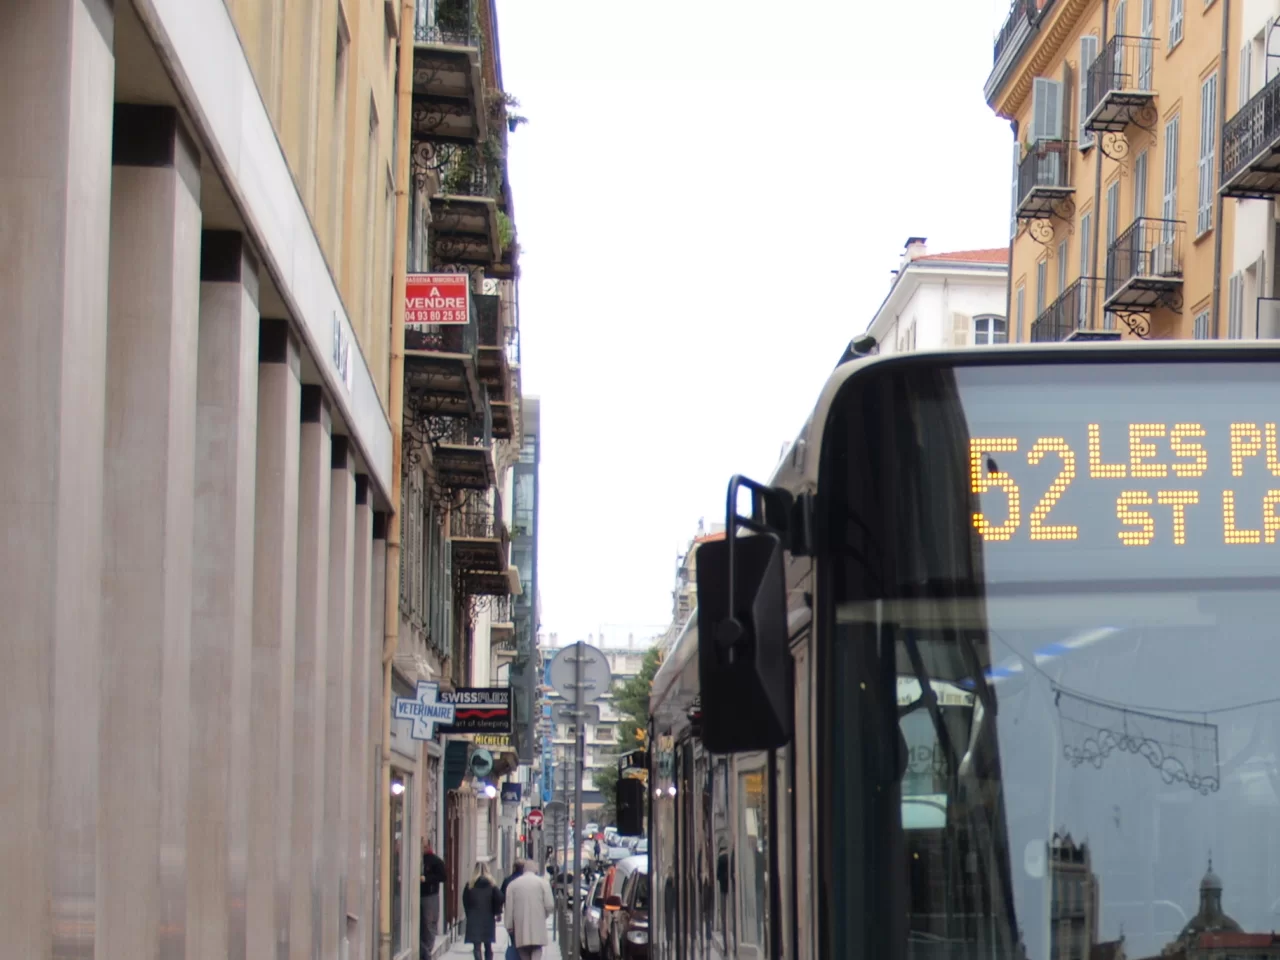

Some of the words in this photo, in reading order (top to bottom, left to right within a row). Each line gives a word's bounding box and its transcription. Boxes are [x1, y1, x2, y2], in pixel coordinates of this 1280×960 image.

[405, 297, 465, 309] VENDRE
[430, 286, 441, 297] A
[405, 311, 415, 321] 04
[417, 311, 428, 321] 93
[430, 311, 441, 321] 80
[443, 310, 454, 321] 25
[455, 310, 466, 321] 55
[1088, 423, 1208, 478] LES
[970, 437, 1077, 541] 52
[1116, 490, 1199, 546] ST
